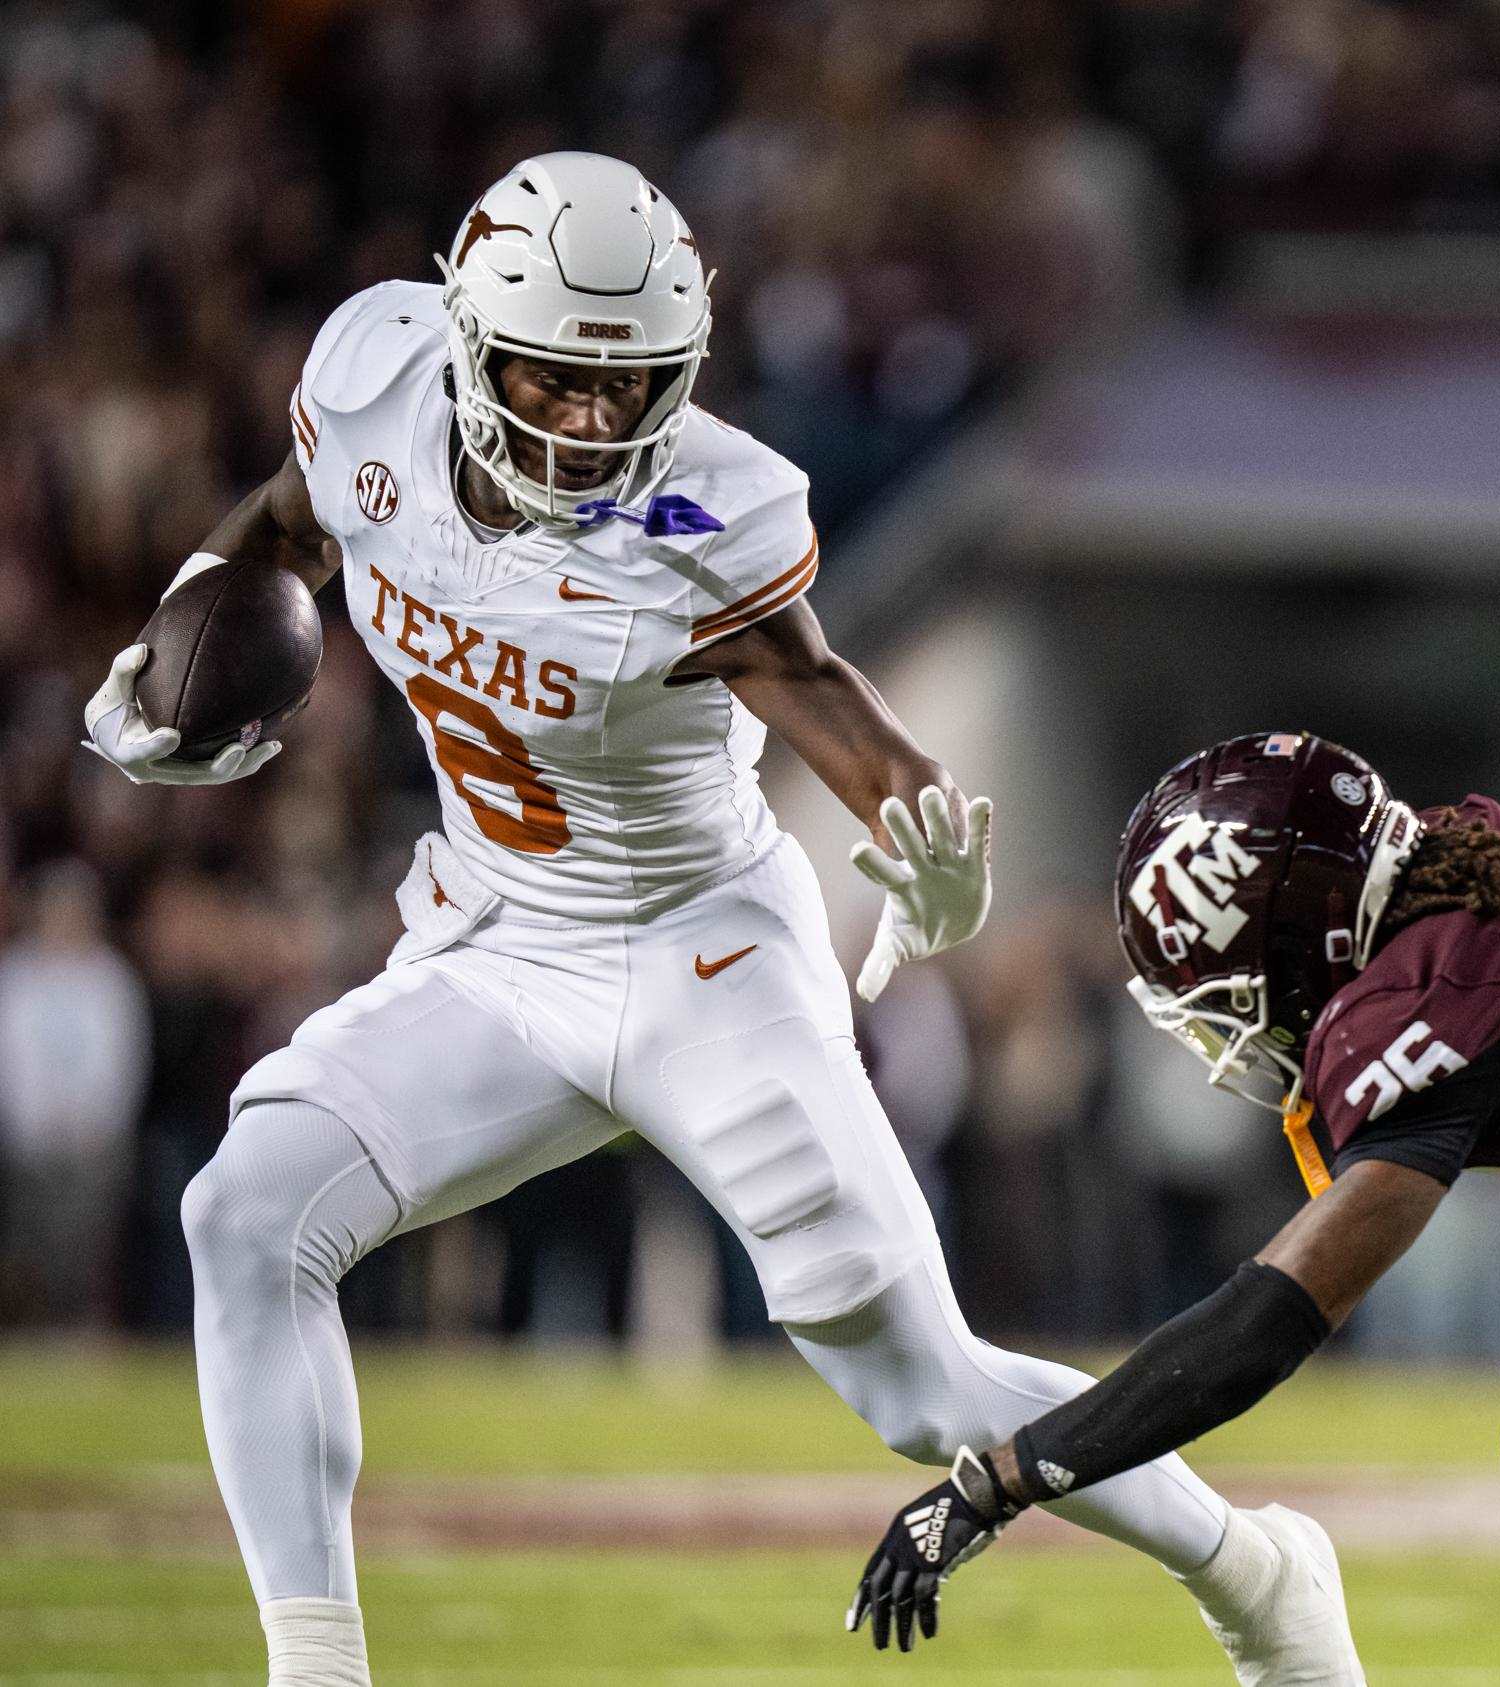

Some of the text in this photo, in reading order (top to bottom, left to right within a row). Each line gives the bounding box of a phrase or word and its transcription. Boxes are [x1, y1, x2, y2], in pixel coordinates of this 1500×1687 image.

[577, 321, 632, 340] HORNS
[357, 463, 398, 521] SEC
[370, 563, 577, 720] TEXAS
[405, 672, 573, 855] 8
[1344, 1020, 1470, 1122] 26
[925, 1497, 952, 1562] adidas
